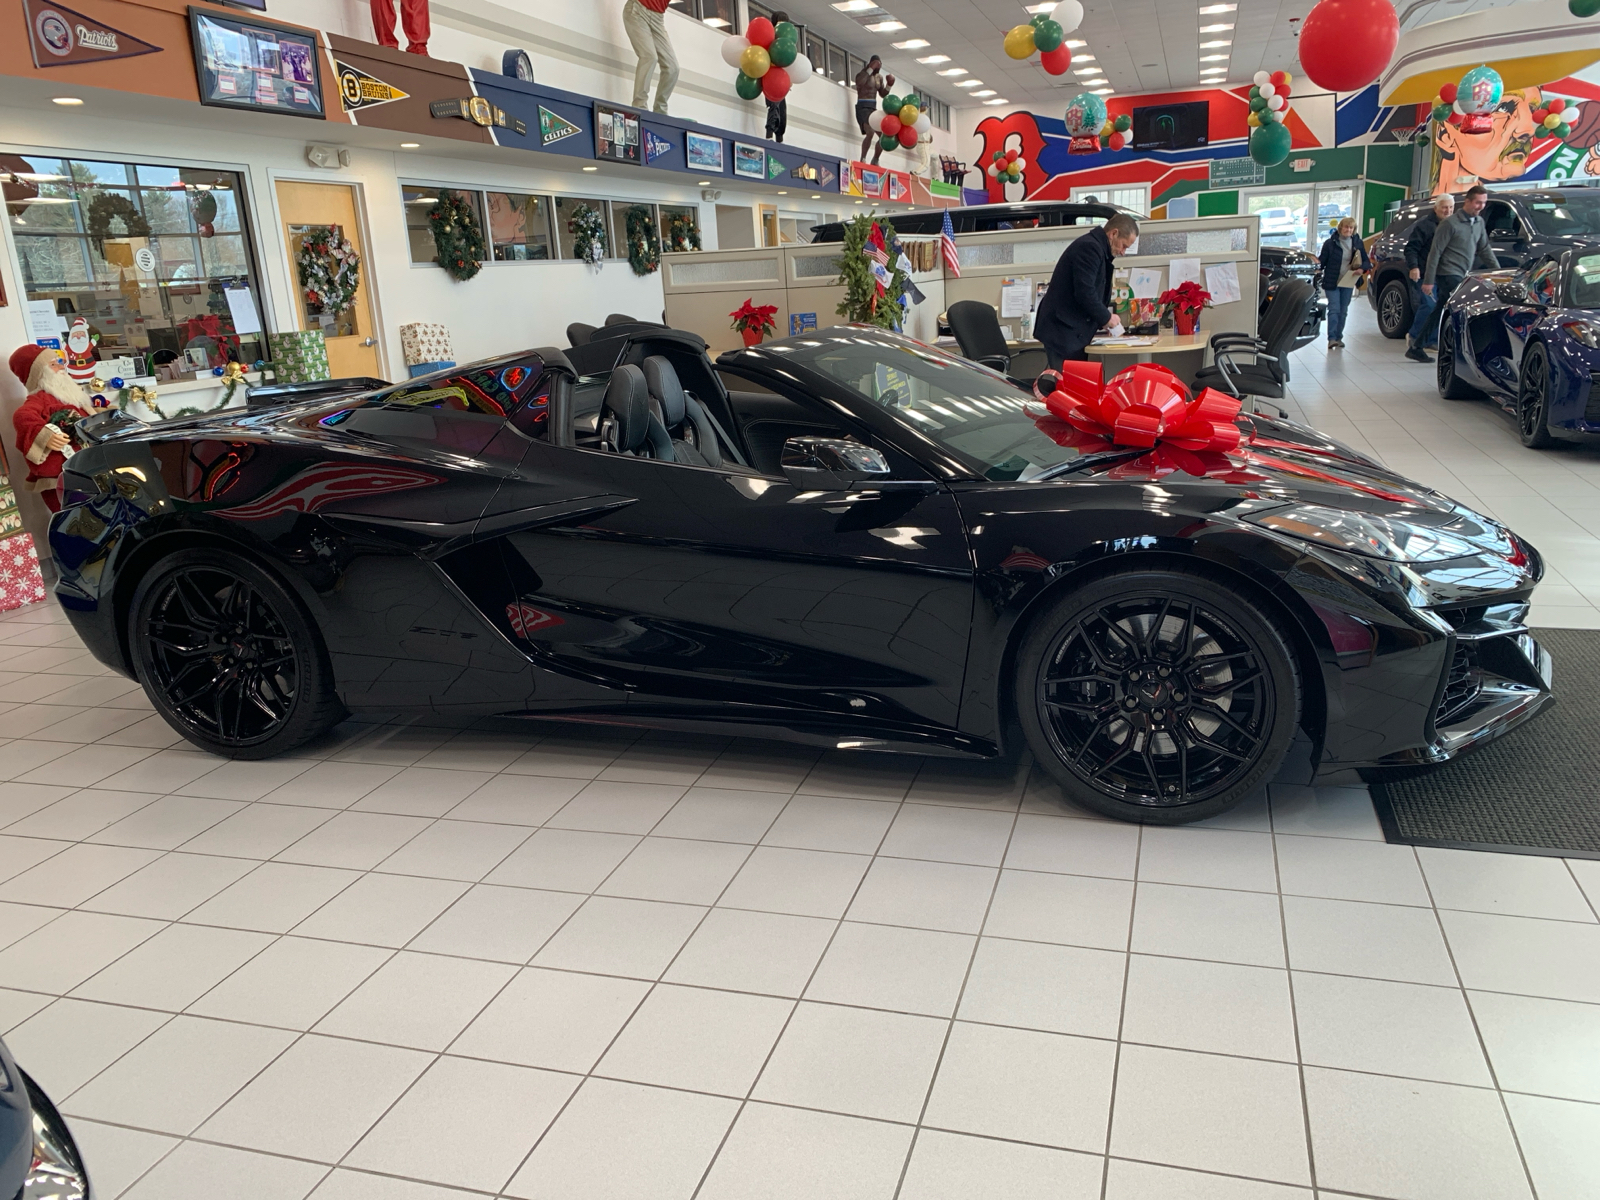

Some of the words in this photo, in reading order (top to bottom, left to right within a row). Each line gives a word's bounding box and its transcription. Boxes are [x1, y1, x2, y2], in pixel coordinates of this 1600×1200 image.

[75, 24, 118, 51] Patriots
[361, 82, 388, 92] BOSTON
[362, 90, 389, 99] BRUINS
[544, 126, 572, 142] CELTICS
[1297, 160, 1309, 168] EXIT
